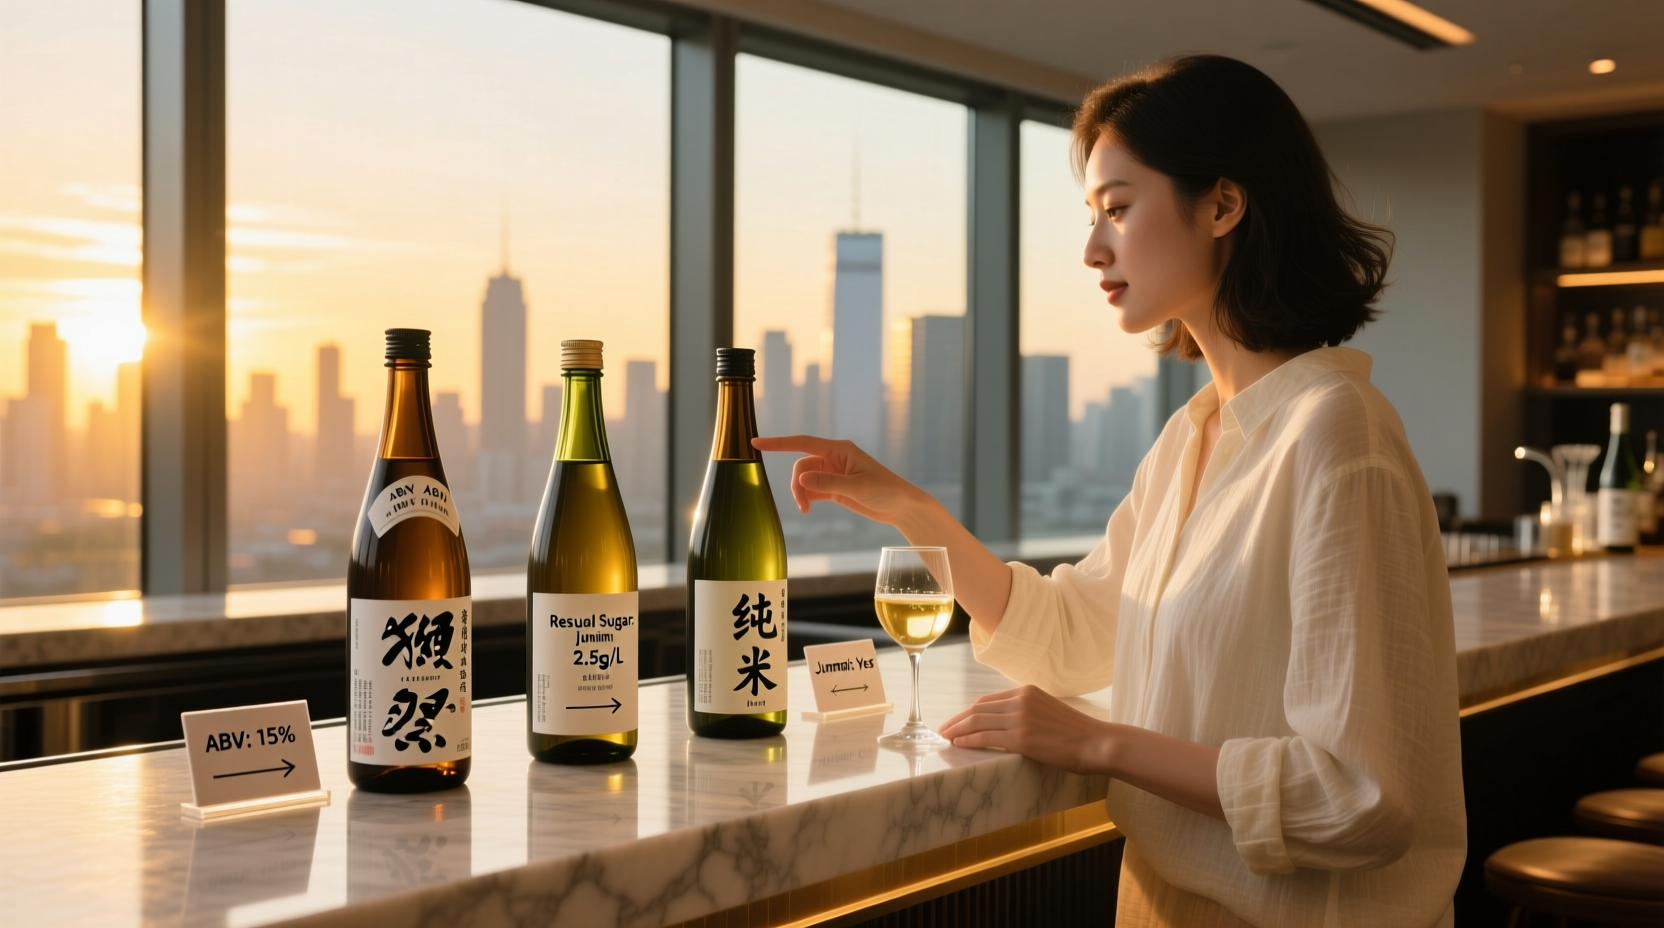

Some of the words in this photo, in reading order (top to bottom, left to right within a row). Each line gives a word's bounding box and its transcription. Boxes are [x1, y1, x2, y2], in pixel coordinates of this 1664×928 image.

[550, 614, 596, 628] Resual
[573, 646, 624, 670] 2.5g/L
[205, 731, 252, 753] ABV:
[256, 725, 296, 746] 15%
